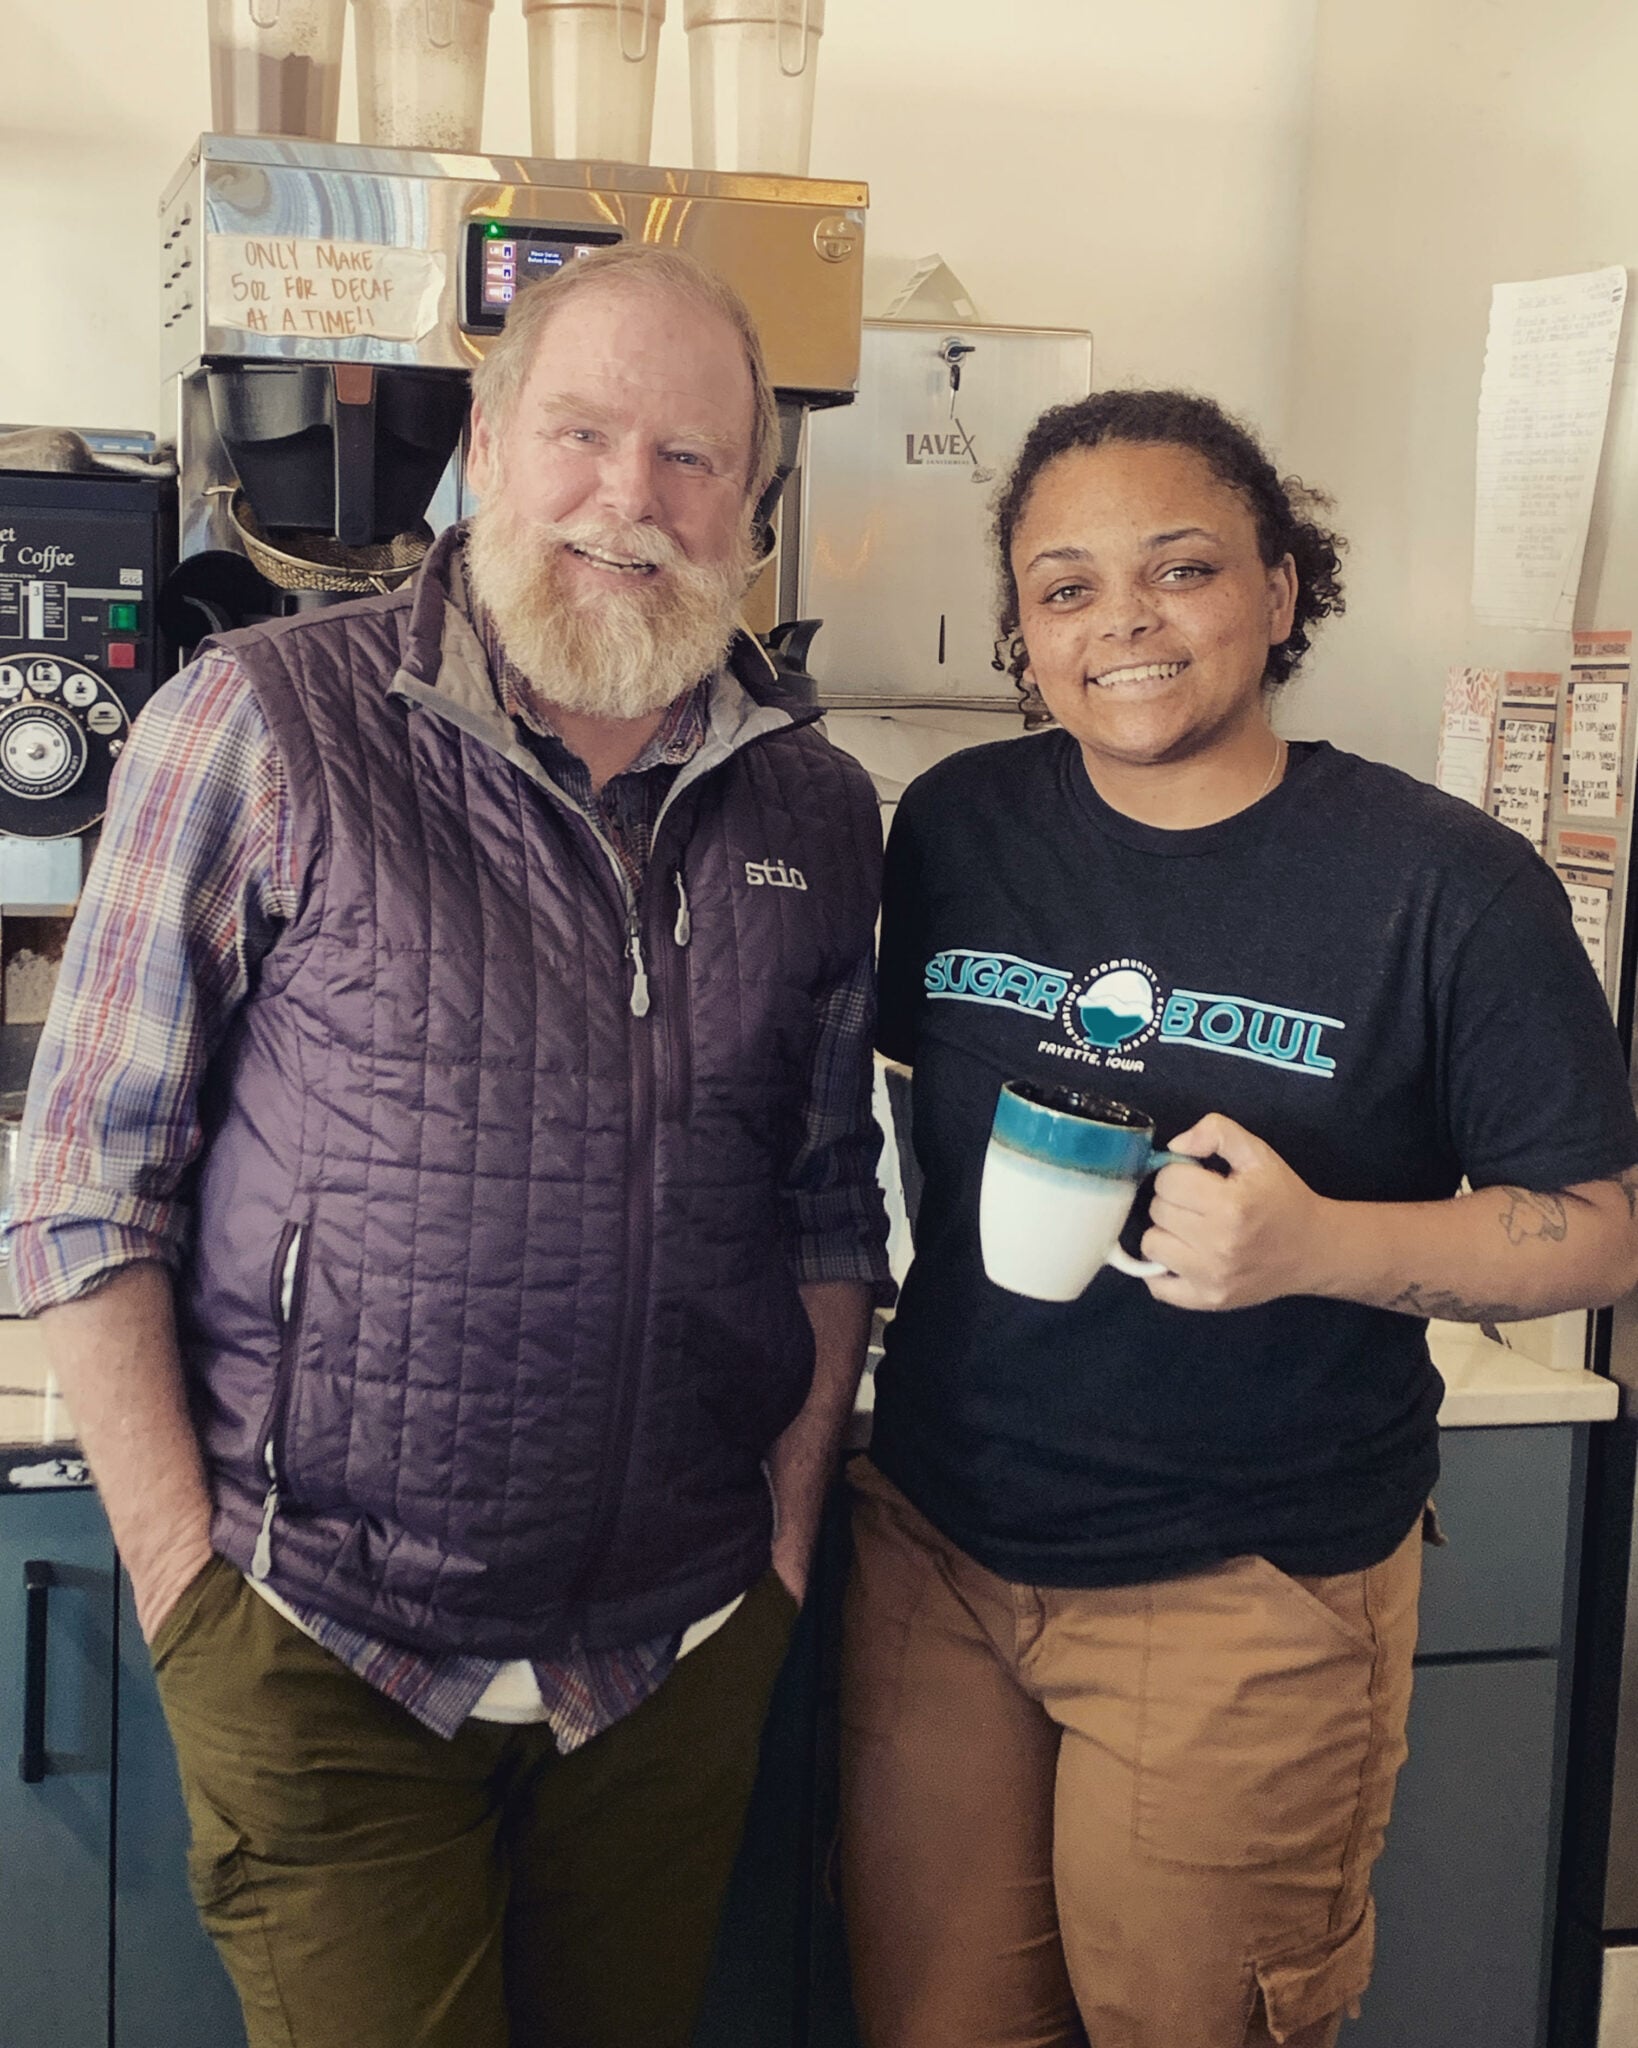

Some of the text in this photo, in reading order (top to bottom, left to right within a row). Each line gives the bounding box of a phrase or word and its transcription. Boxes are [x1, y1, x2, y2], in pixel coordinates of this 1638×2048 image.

[245, 240, 374, 272] ONLY MAKE
[284, 276, 318, 300] FOR
[331, 277, 395, 302] DECAF
[282, 307, 297, 331] A
[906, 418, 978, 465] LAVEX
[18, 545, 76, 573] Coffee
[32, 586, 41, 597] 3
[1090, 958, 1158, 983] COMMUNITY
[924, 955, 1337, 1070] SUGAR BOWL
[1037, 1040, 1145, 1073] FAYETTE, IOWA
